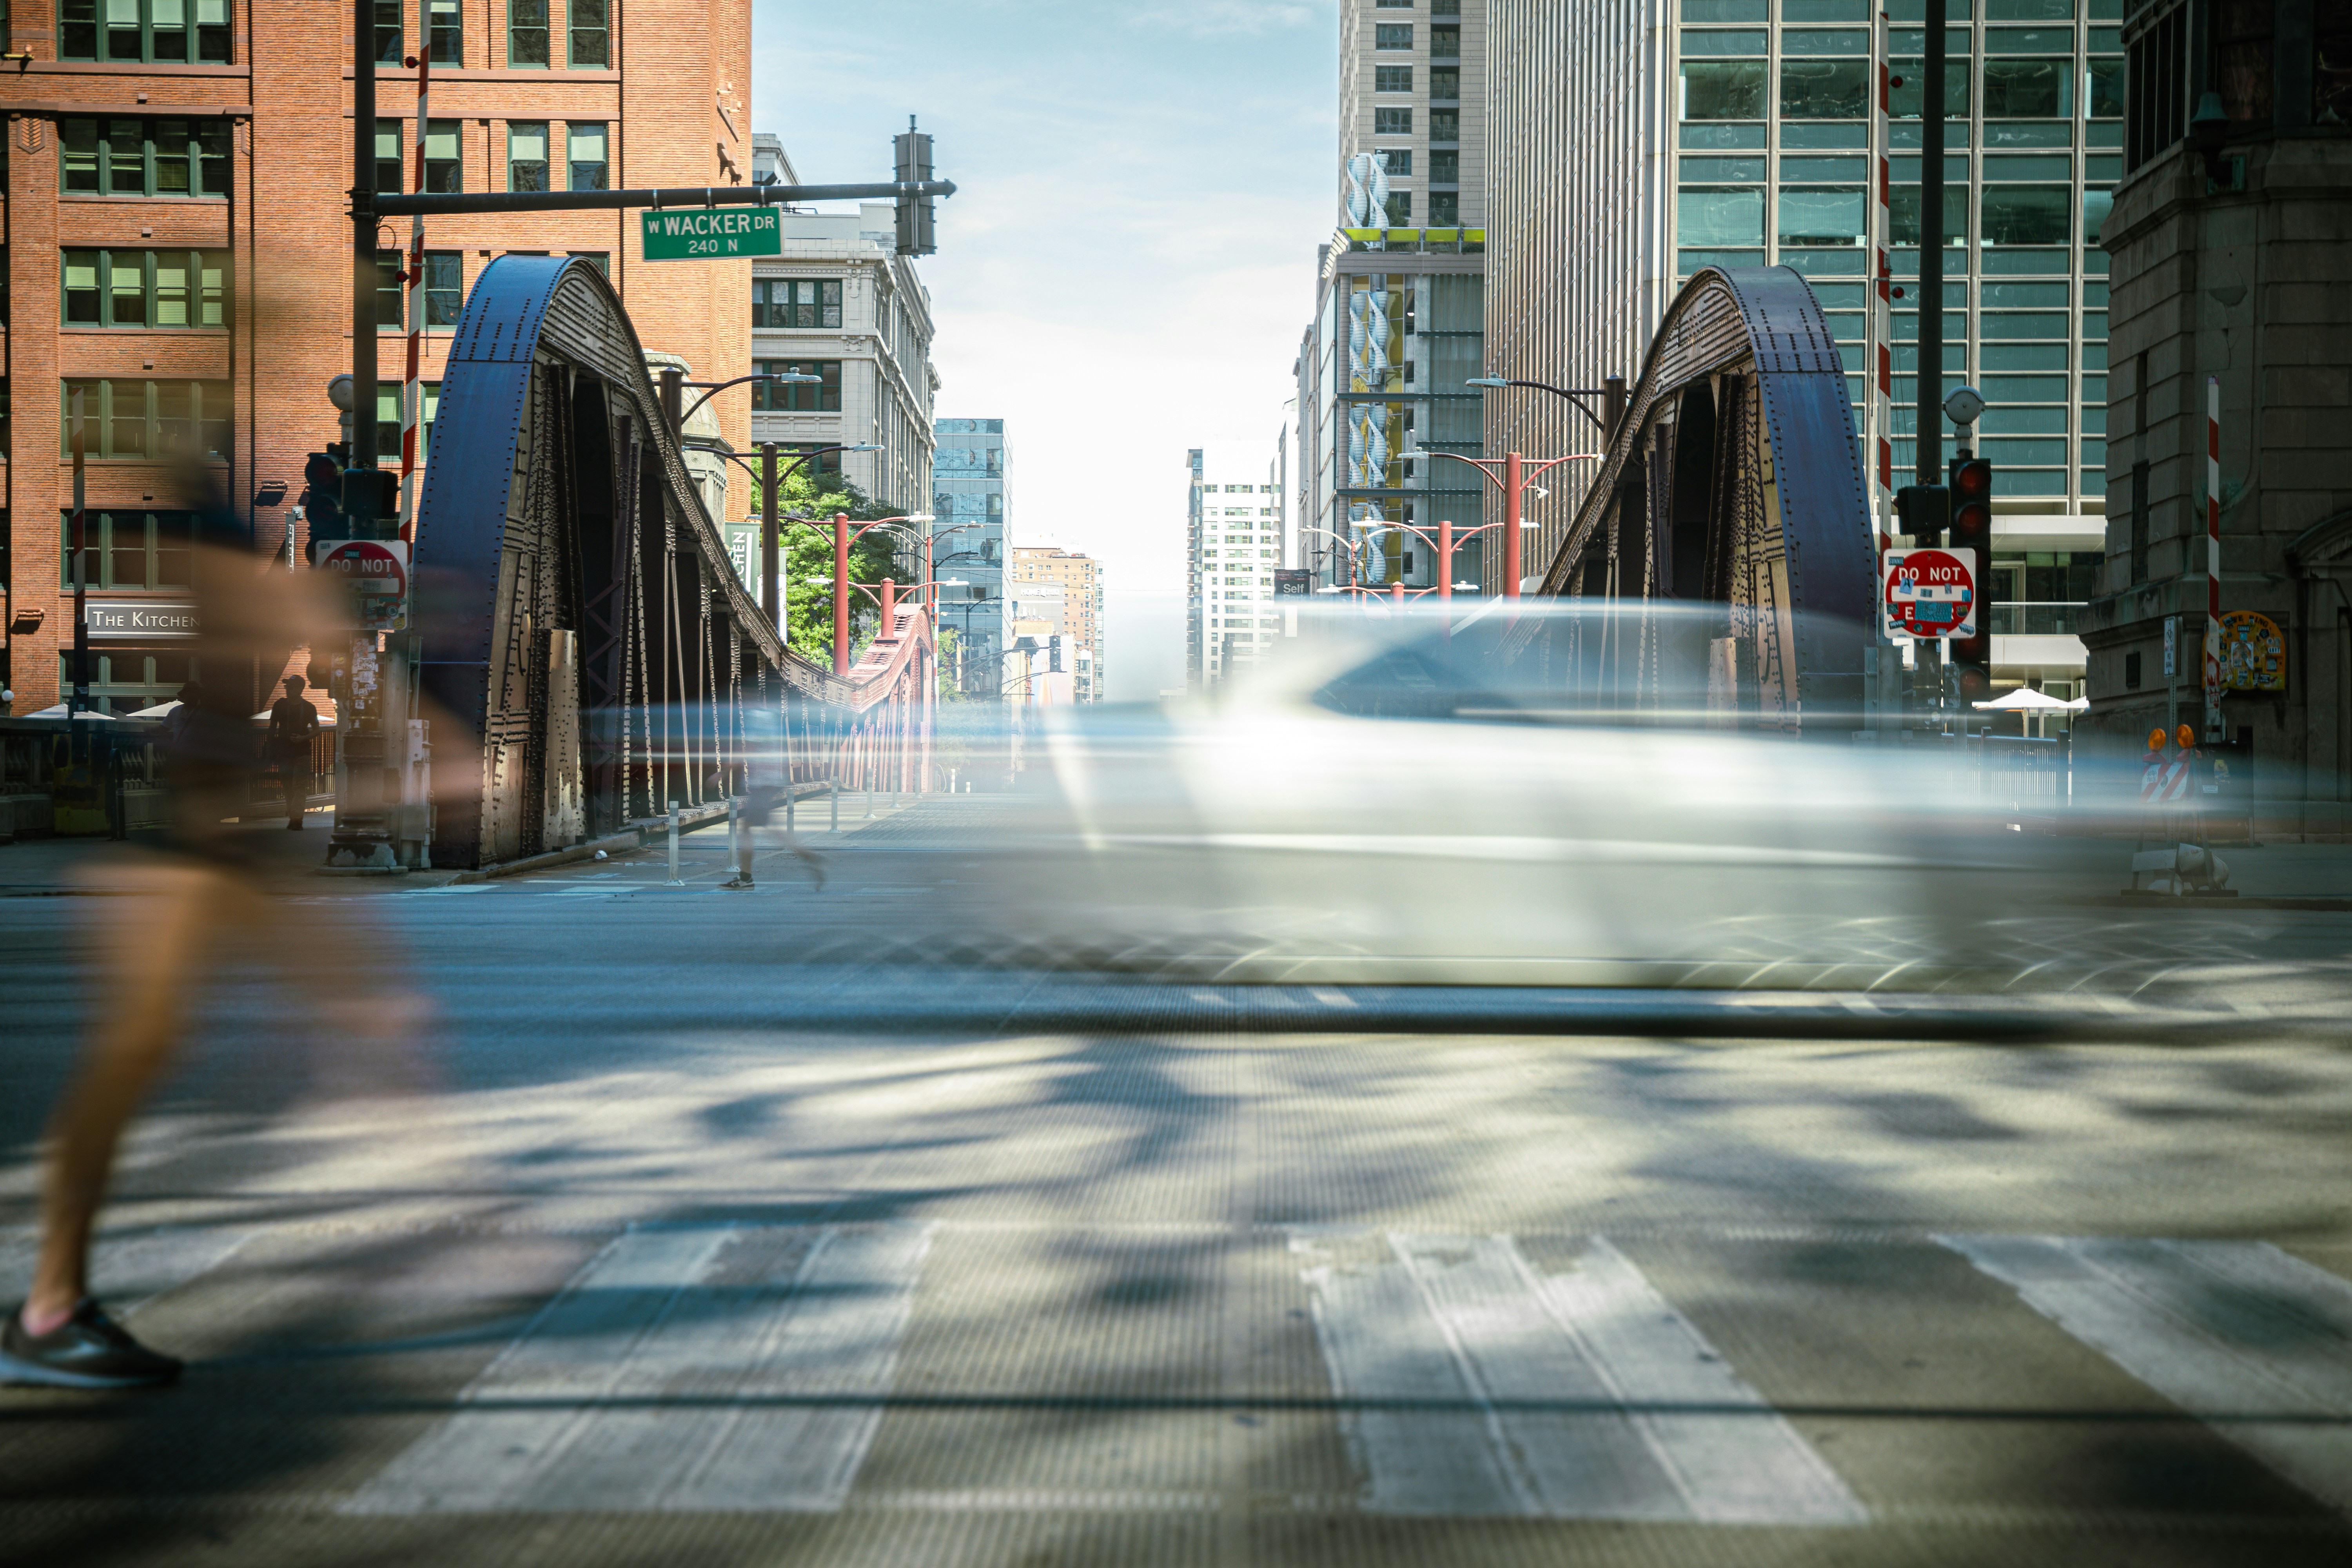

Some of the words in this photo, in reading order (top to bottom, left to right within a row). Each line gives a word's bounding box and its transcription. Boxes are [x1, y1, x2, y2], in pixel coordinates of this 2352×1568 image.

[648, 220, 659, 234] W
[664, 214, 751, 236] WACKER
[753, 216, 775, 230] DR
[688, 240, 718, 253] 240
[728, 239, 738, 252] N
[331, 559, 351, 572] DO
[362, 559, 392, 572] NOT
[1898, 567, 1919, 581] DO
[1929, 567, 1961, 581] NOT
[1283, 583, 1304, 593] Self
